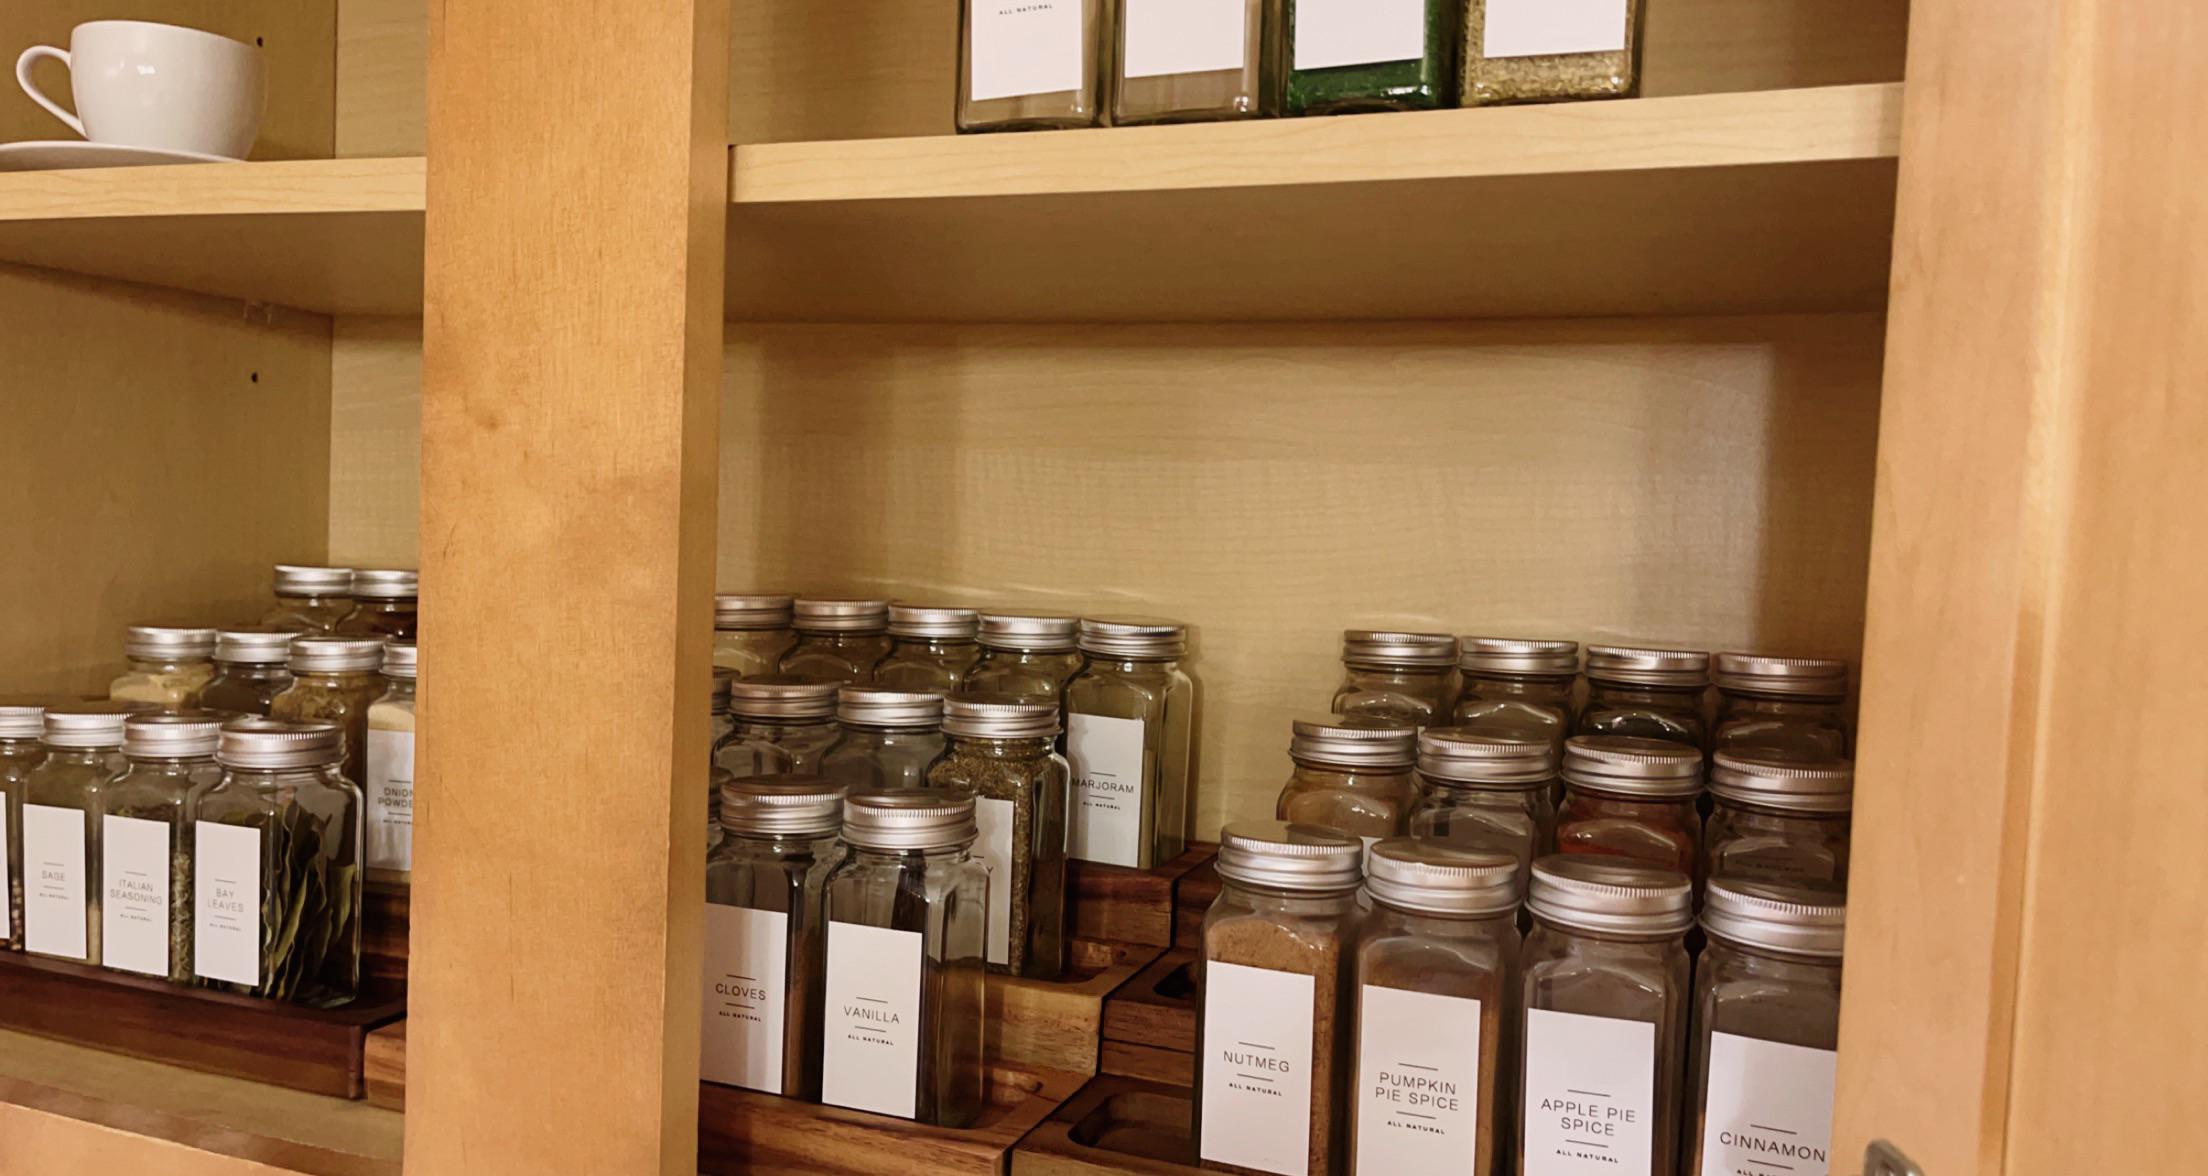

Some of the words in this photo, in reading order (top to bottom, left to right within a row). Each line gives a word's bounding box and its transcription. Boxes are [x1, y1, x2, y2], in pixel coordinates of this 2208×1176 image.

[1017, 4, 1052, 12] NATURAL
[1072, 779, 1134, 793] MARJORAM
[378, 797, 413, 808] POWDE
[41, 870, 66, 882] SAGE
[119, 879, 154, 892] ITALIAN
[110, 889, 163, 905] SEASONING
[216, 888, 234, 898] BAY
[208, 899, 244, 912] LEAVES
[715, 983, 766, 1001] CLOVES
[733, 1013, 762, 1022] NATURAL
[843, 1005, 900, 1024] VANILLA
[863, 1037, 894, 1046] NATURAL
[1223, 1051, 1290, 1073] NUTMEG
[1379, 1072, 1456, 1095] PUMPKIN
[1246, 1086, 1282, 1097] NATURAL
[1375, 1087, 1401, 1102] PIE
[1408, 1092, 1459, 1111] SPICE
[1541, 1098, 1599, 1118] APPLE
[1607, 1106, 1636, 1123] PIE
[1387, 1120, 1402, 1128] ALL
[1406, 1123, 1445, 1135] NATURAL
[1560, 1117, 1614, 1136] SPICE
[1720, 1131, 1826, 1163] CINNAMON
[1576, 1152, 1619, 1164] NATURAL
